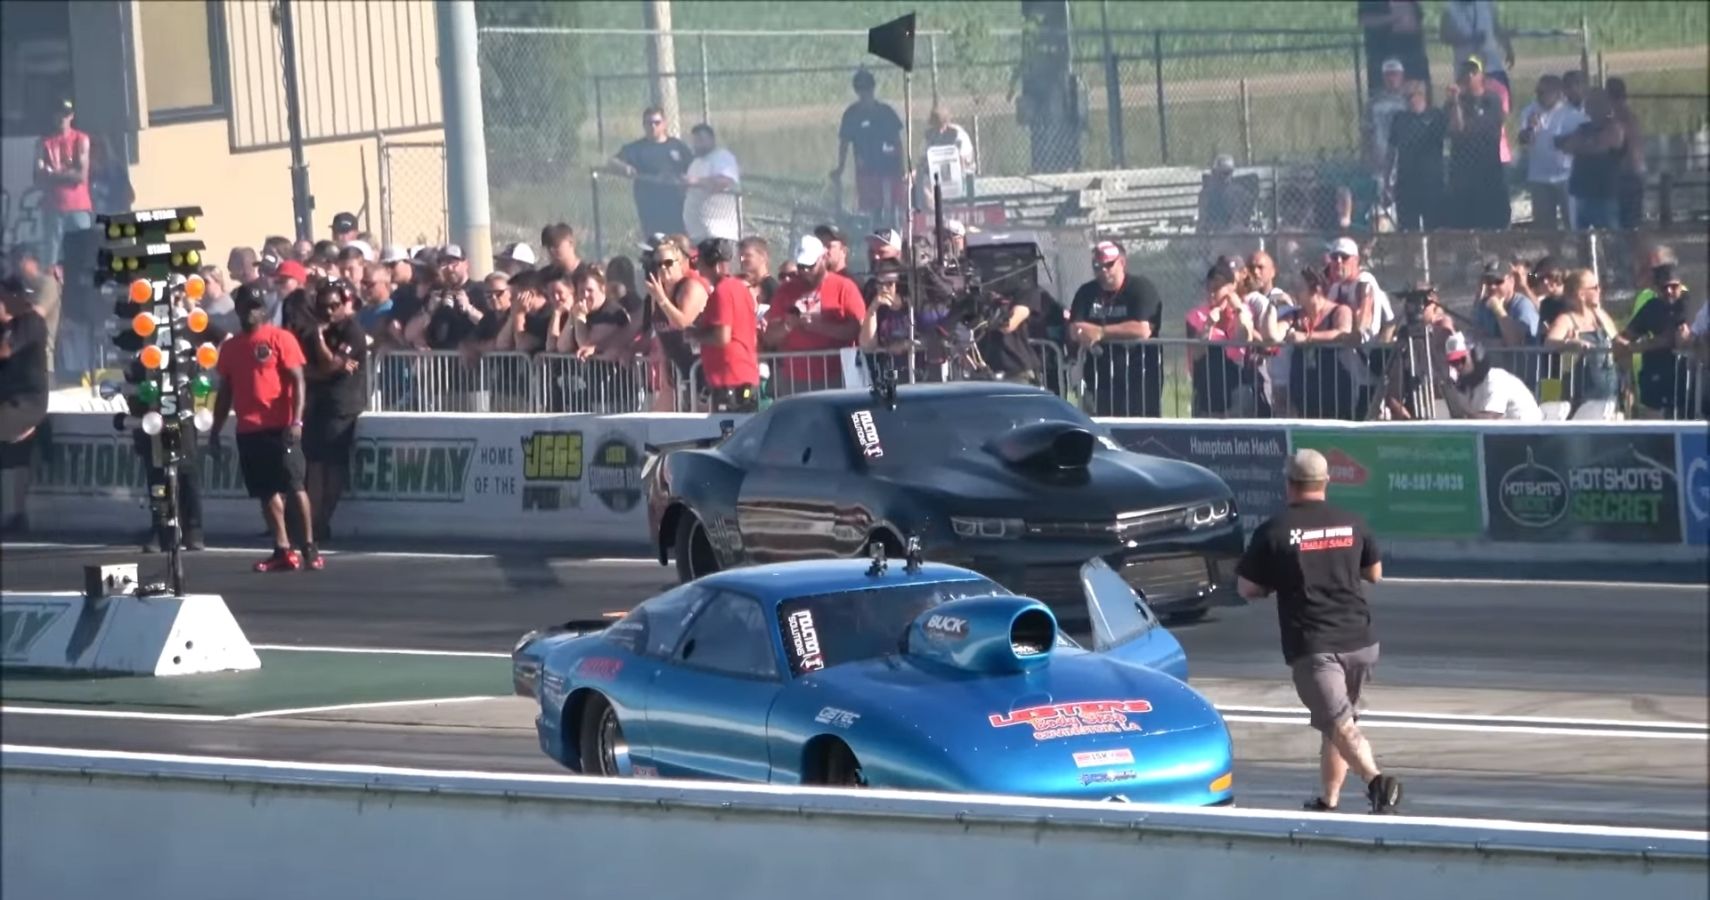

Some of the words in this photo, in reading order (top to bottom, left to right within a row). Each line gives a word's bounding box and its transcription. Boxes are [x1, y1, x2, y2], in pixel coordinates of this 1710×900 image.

[480, 448, 514, 465] HOME
[521, 430, 583, 480] JEGS
[1190, 436, 1232, 458] Hampton
[1234, 437, 1250, 455] Inn
[354, 446, 472, 493] CEWAY
[474, 477, 491, 494] OF
[494, 477, 516, 495] THE
[1573, 493, 1663, 523] SECRET
[788, 616, 805, 656] SOLUTIONS
[927, 614, 967, 633] BUCK
